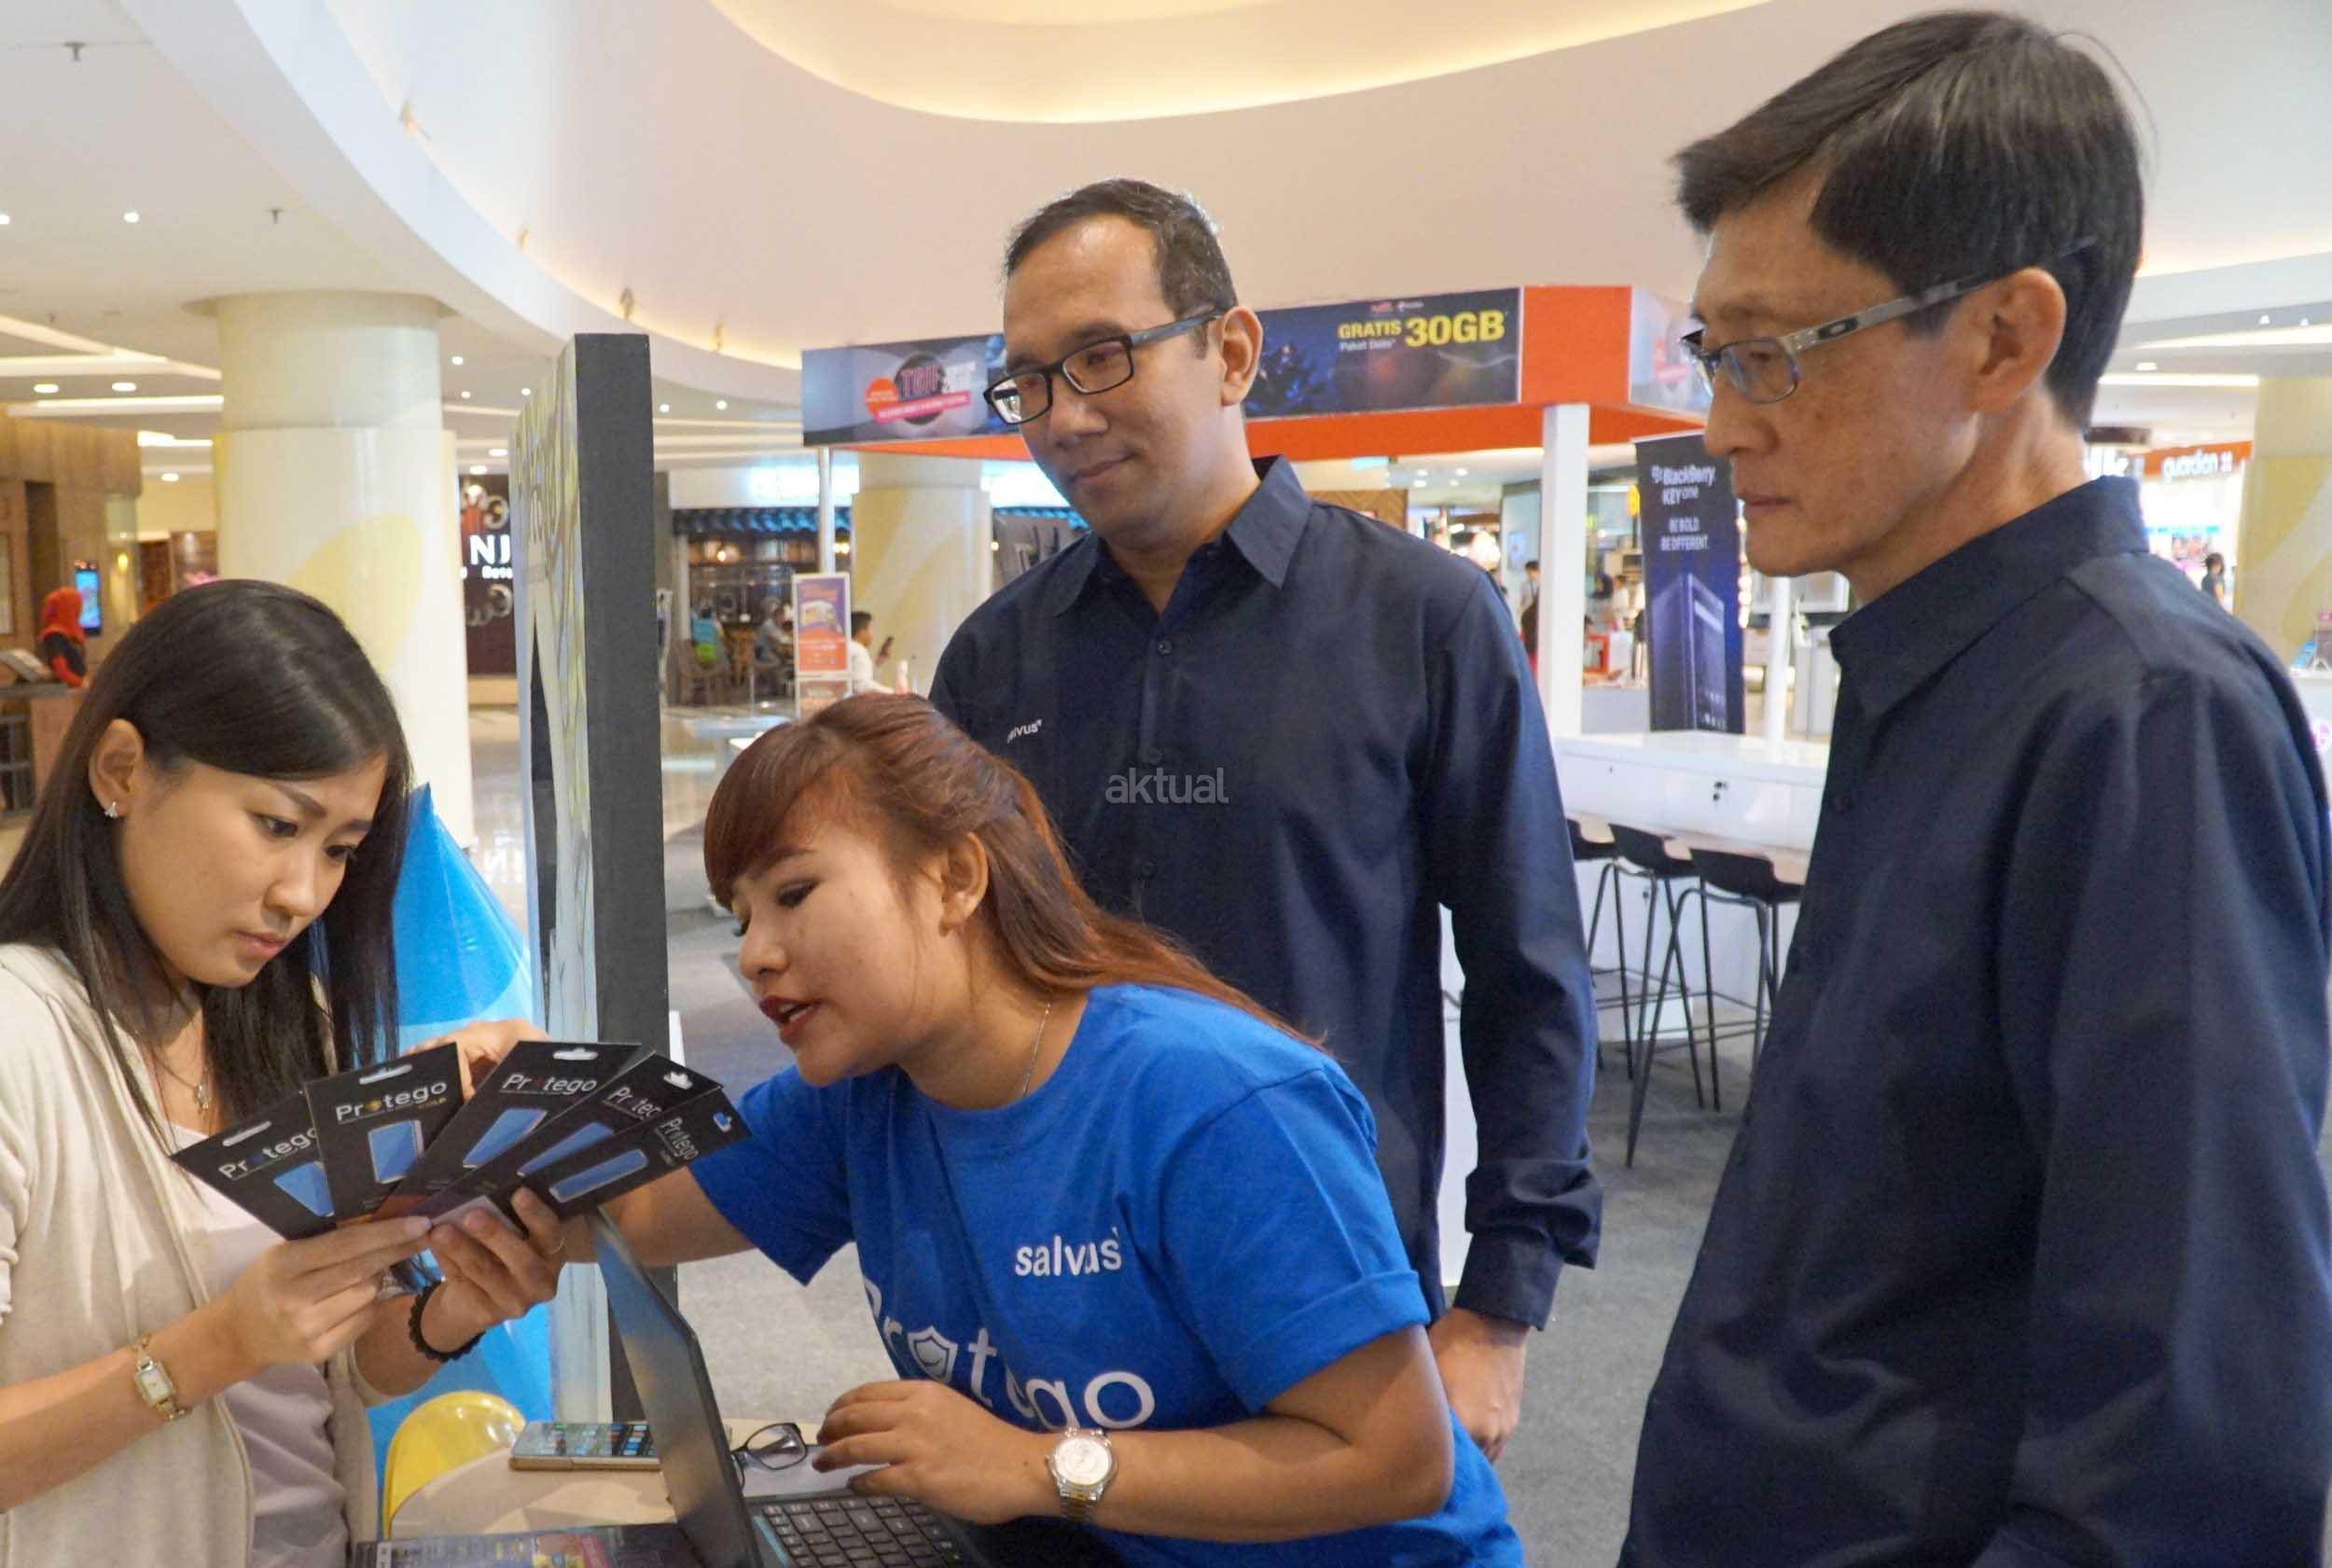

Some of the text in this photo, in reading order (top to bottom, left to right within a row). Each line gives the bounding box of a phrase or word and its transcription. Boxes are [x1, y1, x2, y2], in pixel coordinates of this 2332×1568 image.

[1338, 310, 1505, 347] GRATIS 30GB
[1663, 465, 1715, 487] BlackBerry
[335, 1082, 448, 1121] Protego
